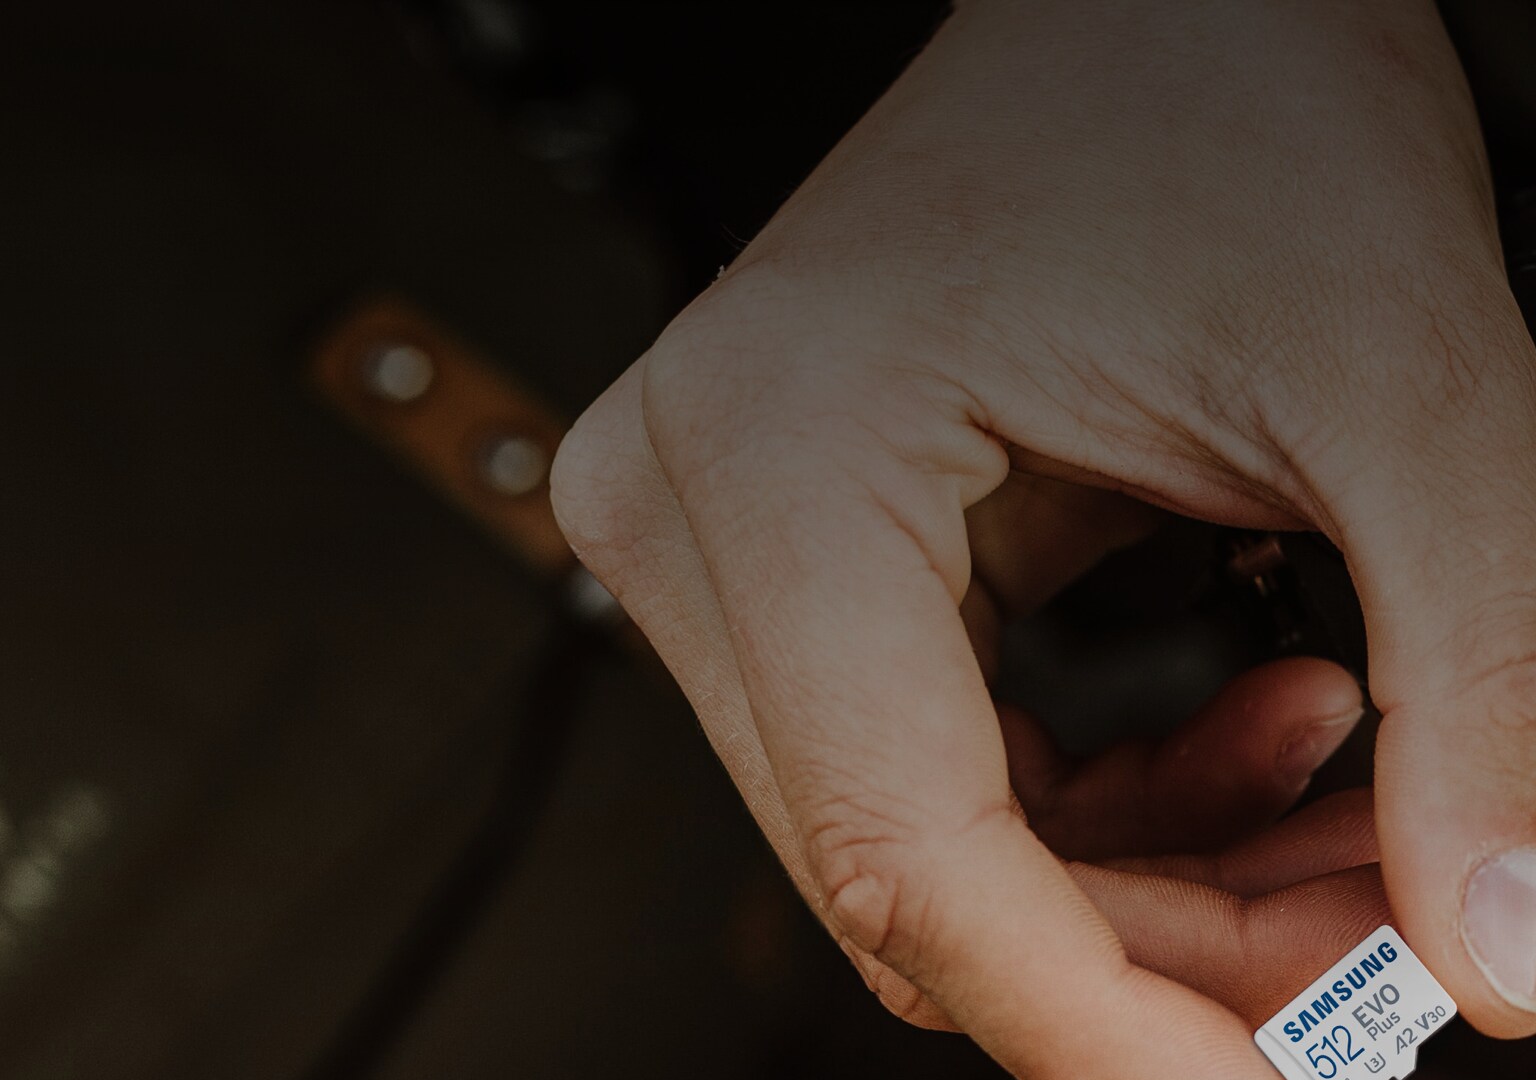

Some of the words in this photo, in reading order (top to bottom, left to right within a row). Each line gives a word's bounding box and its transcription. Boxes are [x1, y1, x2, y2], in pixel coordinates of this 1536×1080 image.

[1283, 942, 1398, 1043] SAMSUNG
[1366, 1010, 1402, 1041] Plus
[1305, 1025, 1365, 1080] 512
[1352, 983, 1400, 1029] EVO
[1395, 1028, 1418, 1055] A2
[1414, 1005, 1446, 1031] V30
